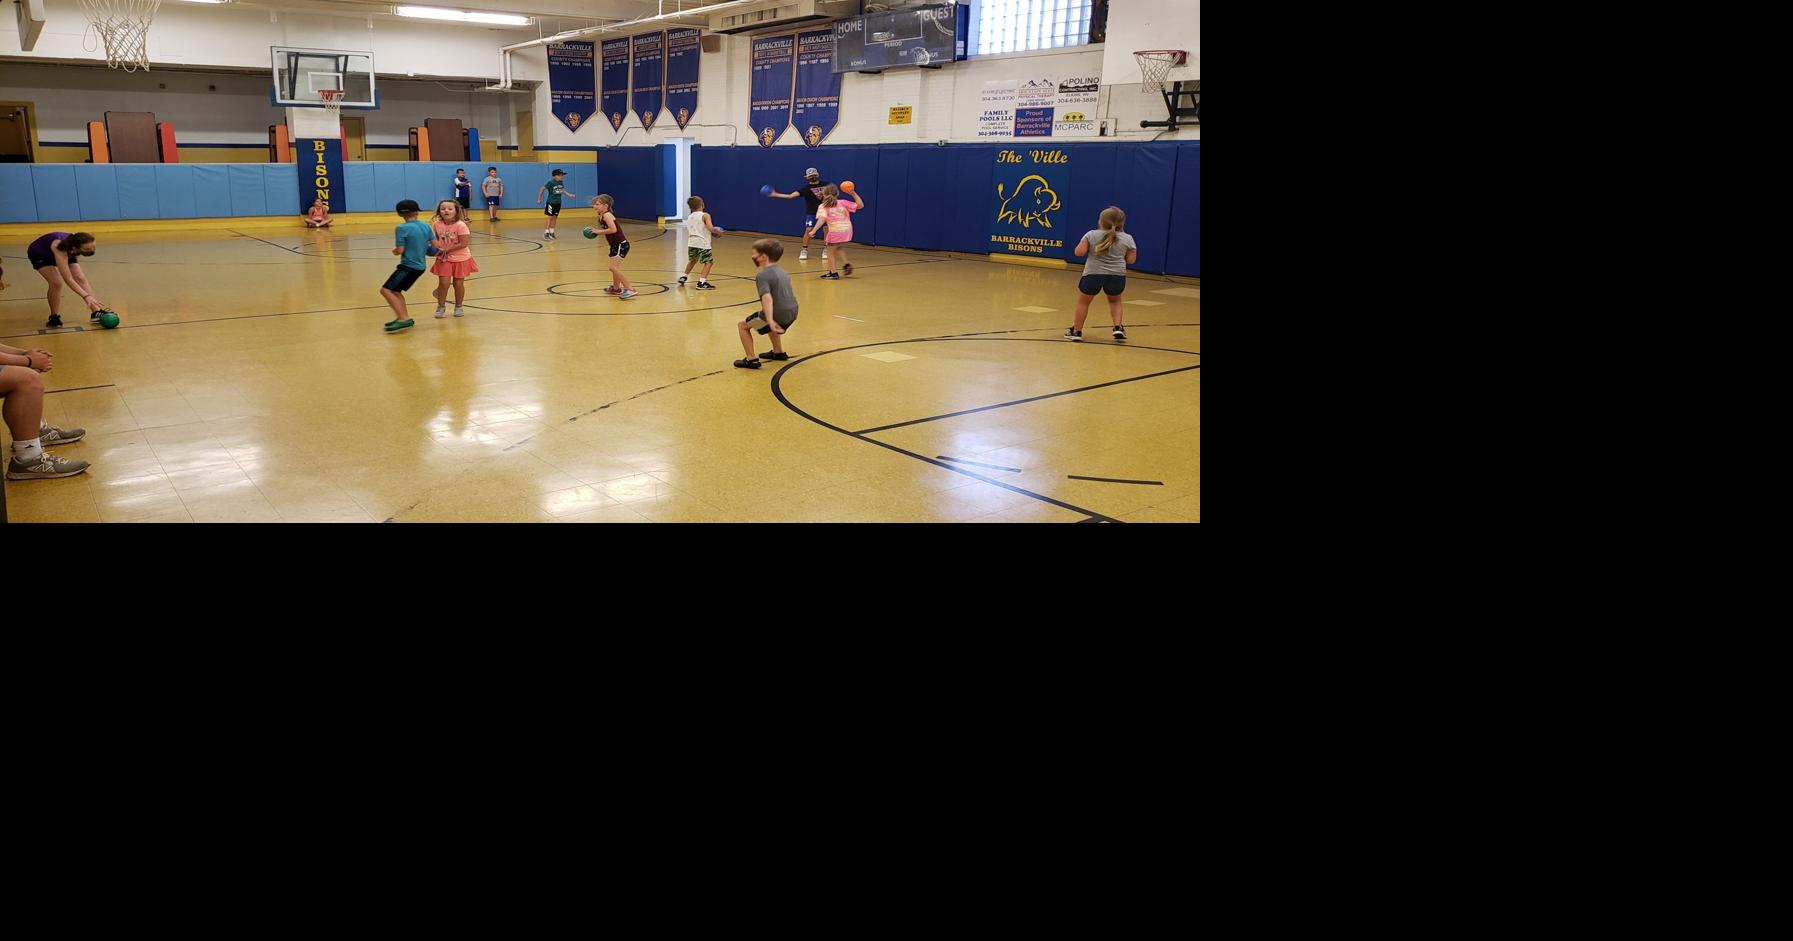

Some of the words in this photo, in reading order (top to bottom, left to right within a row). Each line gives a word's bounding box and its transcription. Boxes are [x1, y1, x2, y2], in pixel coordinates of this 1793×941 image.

[923, 6, 954, 20] GUEST
[838, 20, 862, 34] HOME
[754, 40, 792, 50] BARRACKVILLE
[996, 150, 1022, 164] The
[1029, 150, 1068, 164] 'Ville
[992, 235, 1063, 247] BARRACKVILLE
[1008, 244, 1043, 253] BISONS
